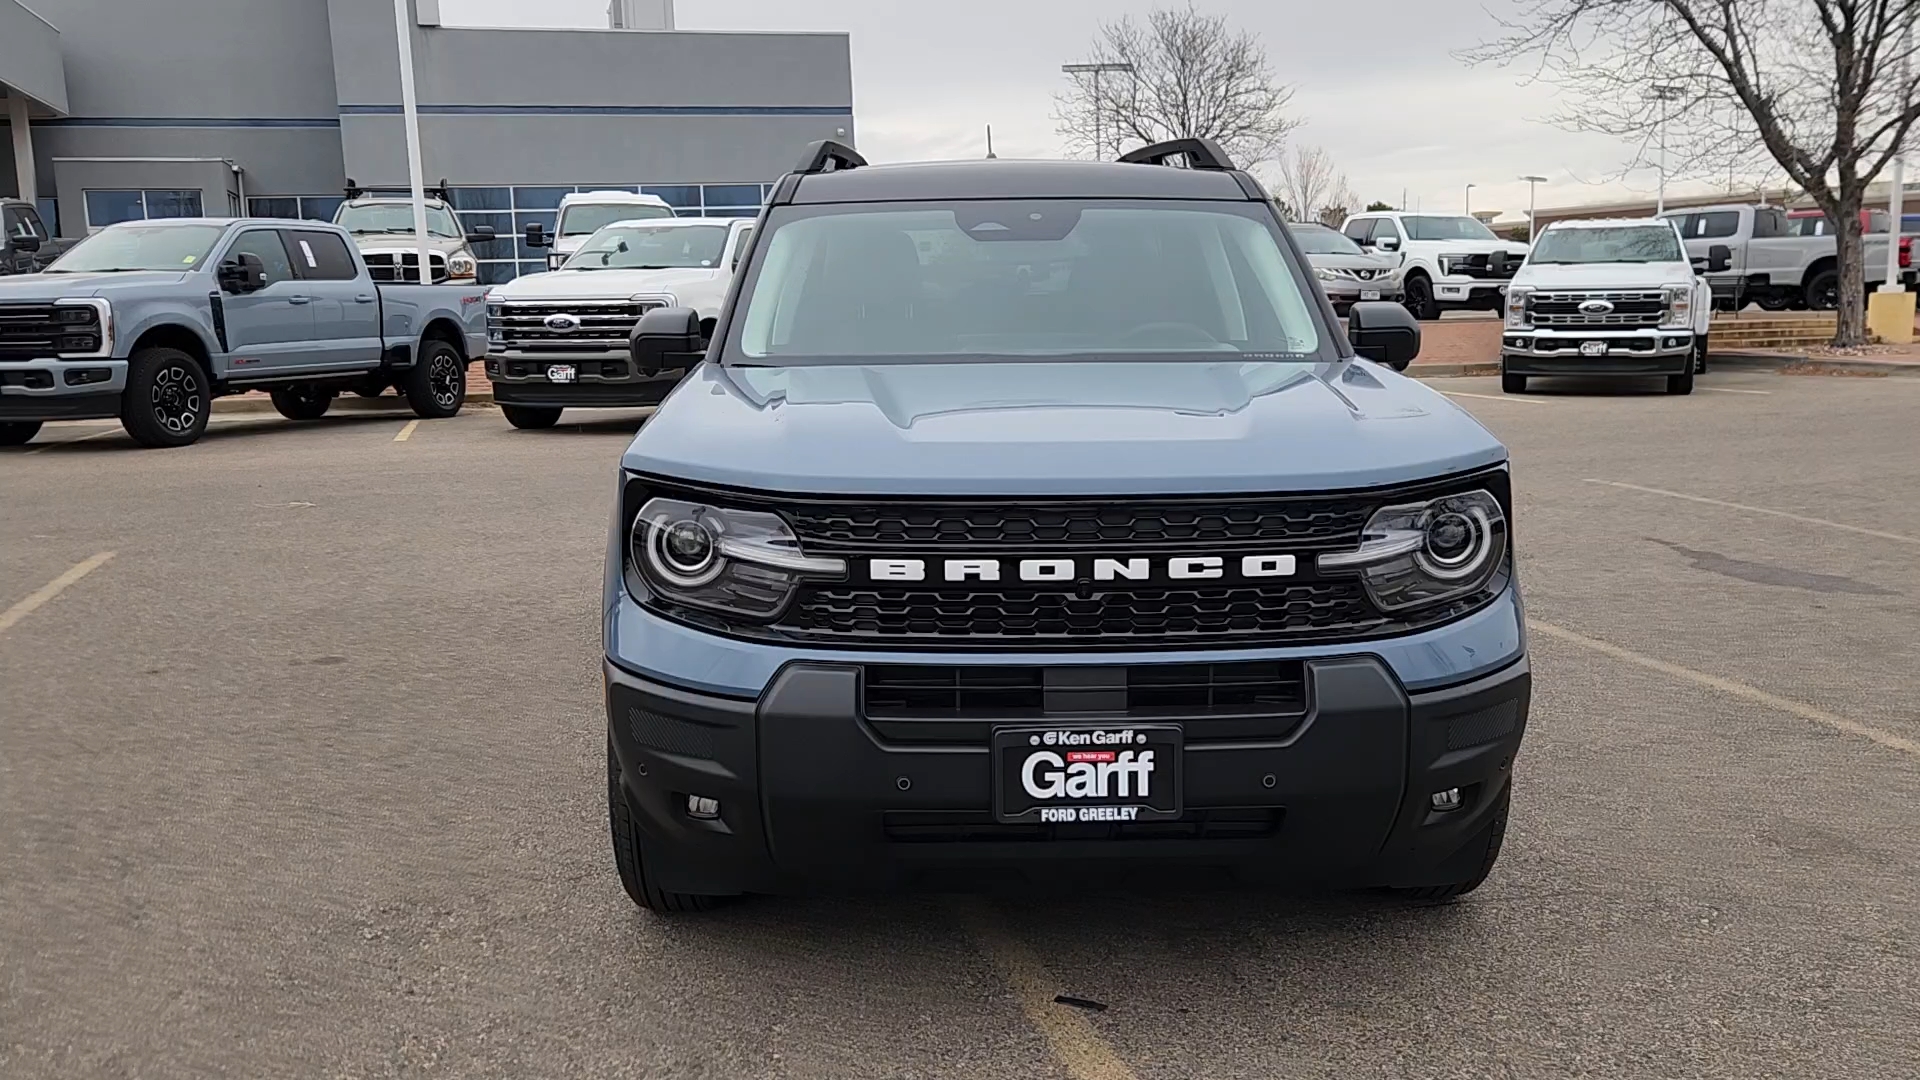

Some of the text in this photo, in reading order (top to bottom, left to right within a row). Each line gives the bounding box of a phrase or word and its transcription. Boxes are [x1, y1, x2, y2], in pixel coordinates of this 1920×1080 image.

[547, 367, 575, 380] Garff
[869, 554, 1296, 581] BRONCO
[1058, 730, 1133, 745] Ken Garff
[1083, 752, 1097, 760] hear
[1098, 753, 1110, 761] you
[1021, 750, 1154, 799] Garff
[1041, 807, 1138, 822] FORD GREELEY
